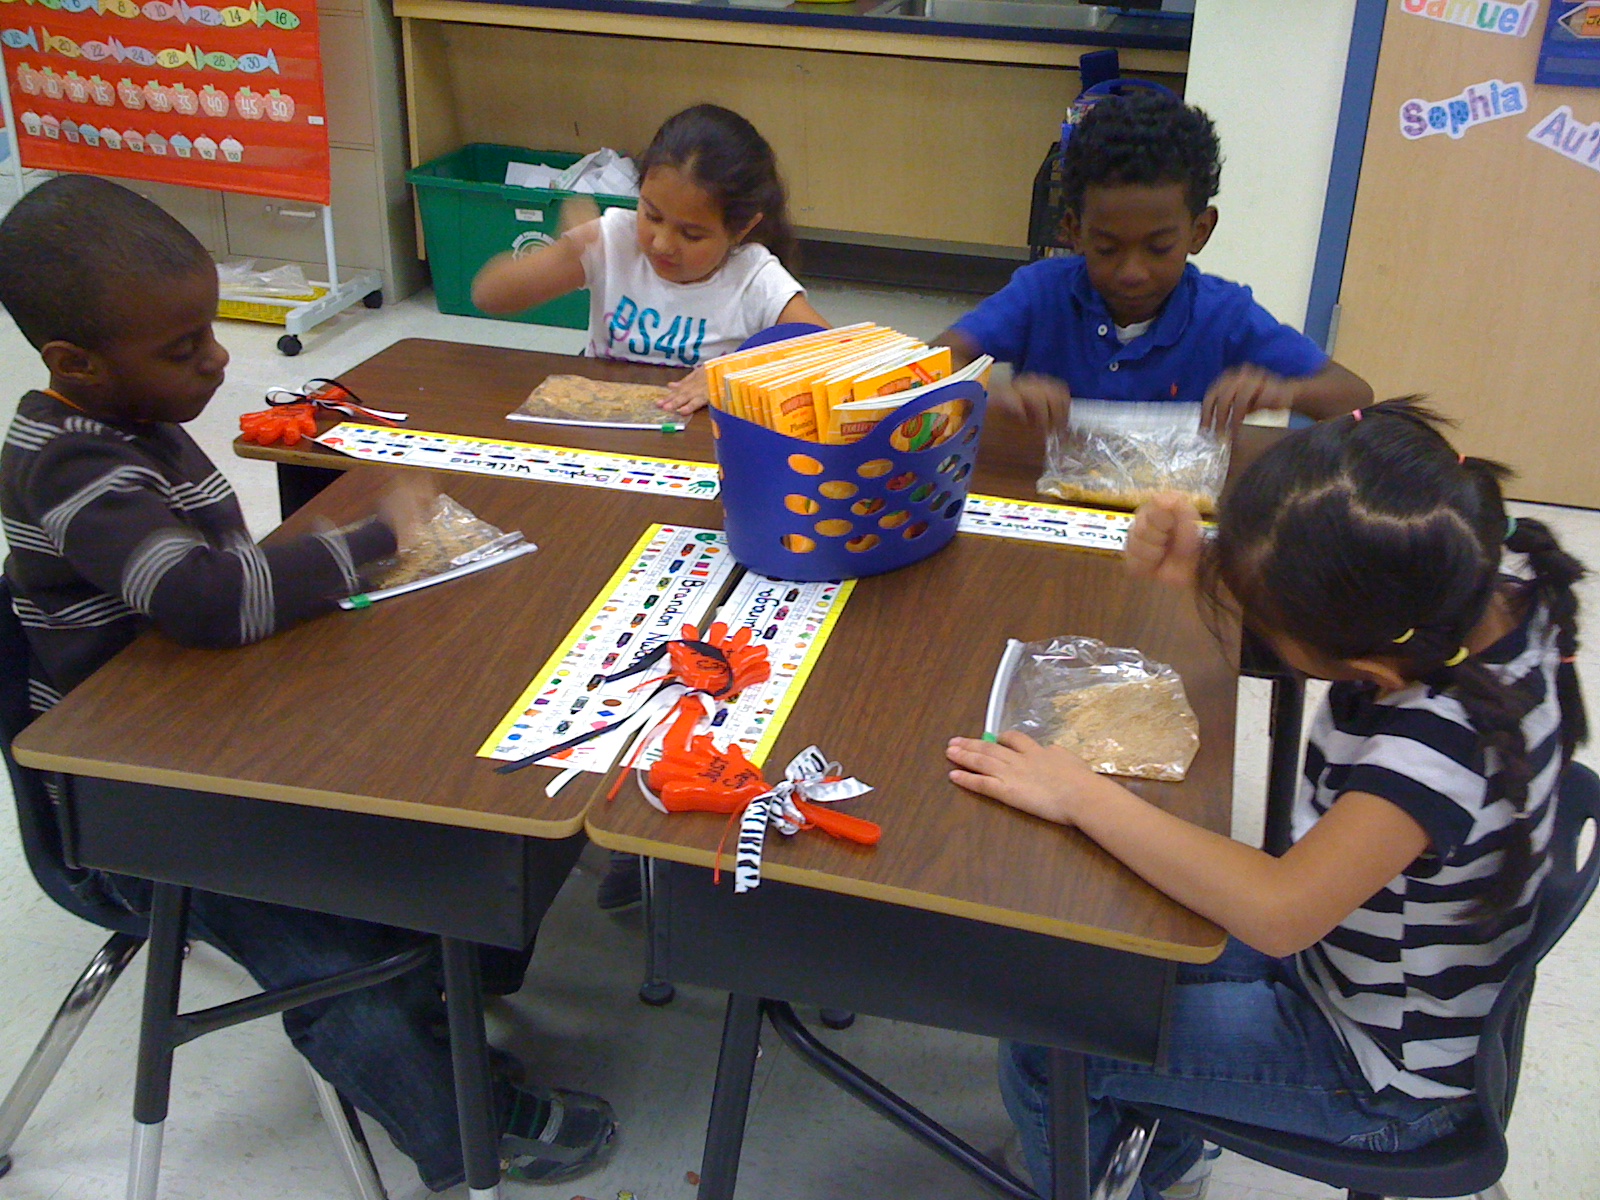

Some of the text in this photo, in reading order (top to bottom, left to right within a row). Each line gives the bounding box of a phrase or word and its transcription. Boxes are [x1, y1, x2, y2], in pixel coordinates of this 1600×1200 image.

[118, 0, 126, 13] 8
[154, 4, 167, 17] 10
[199, 9, 211, 23] 12
[228, 9, 241, 23] 14
[59, 38, 72, 53] 20
[90, 44, 104, 57] 22
[131, 48, 145, 61] 24
[212, 54, 226, 67] 28
[247, 55, 261, 69] 30
[206, 96, 223, 113] 40
[240, 98, 258, 116] 45
[271, 101, 288, 118] 50
[1402, 81, 1523, 136] Sophia
[970, 517, 1068, 538] Ramirez
[655, 579, 706, 628] Brandon
